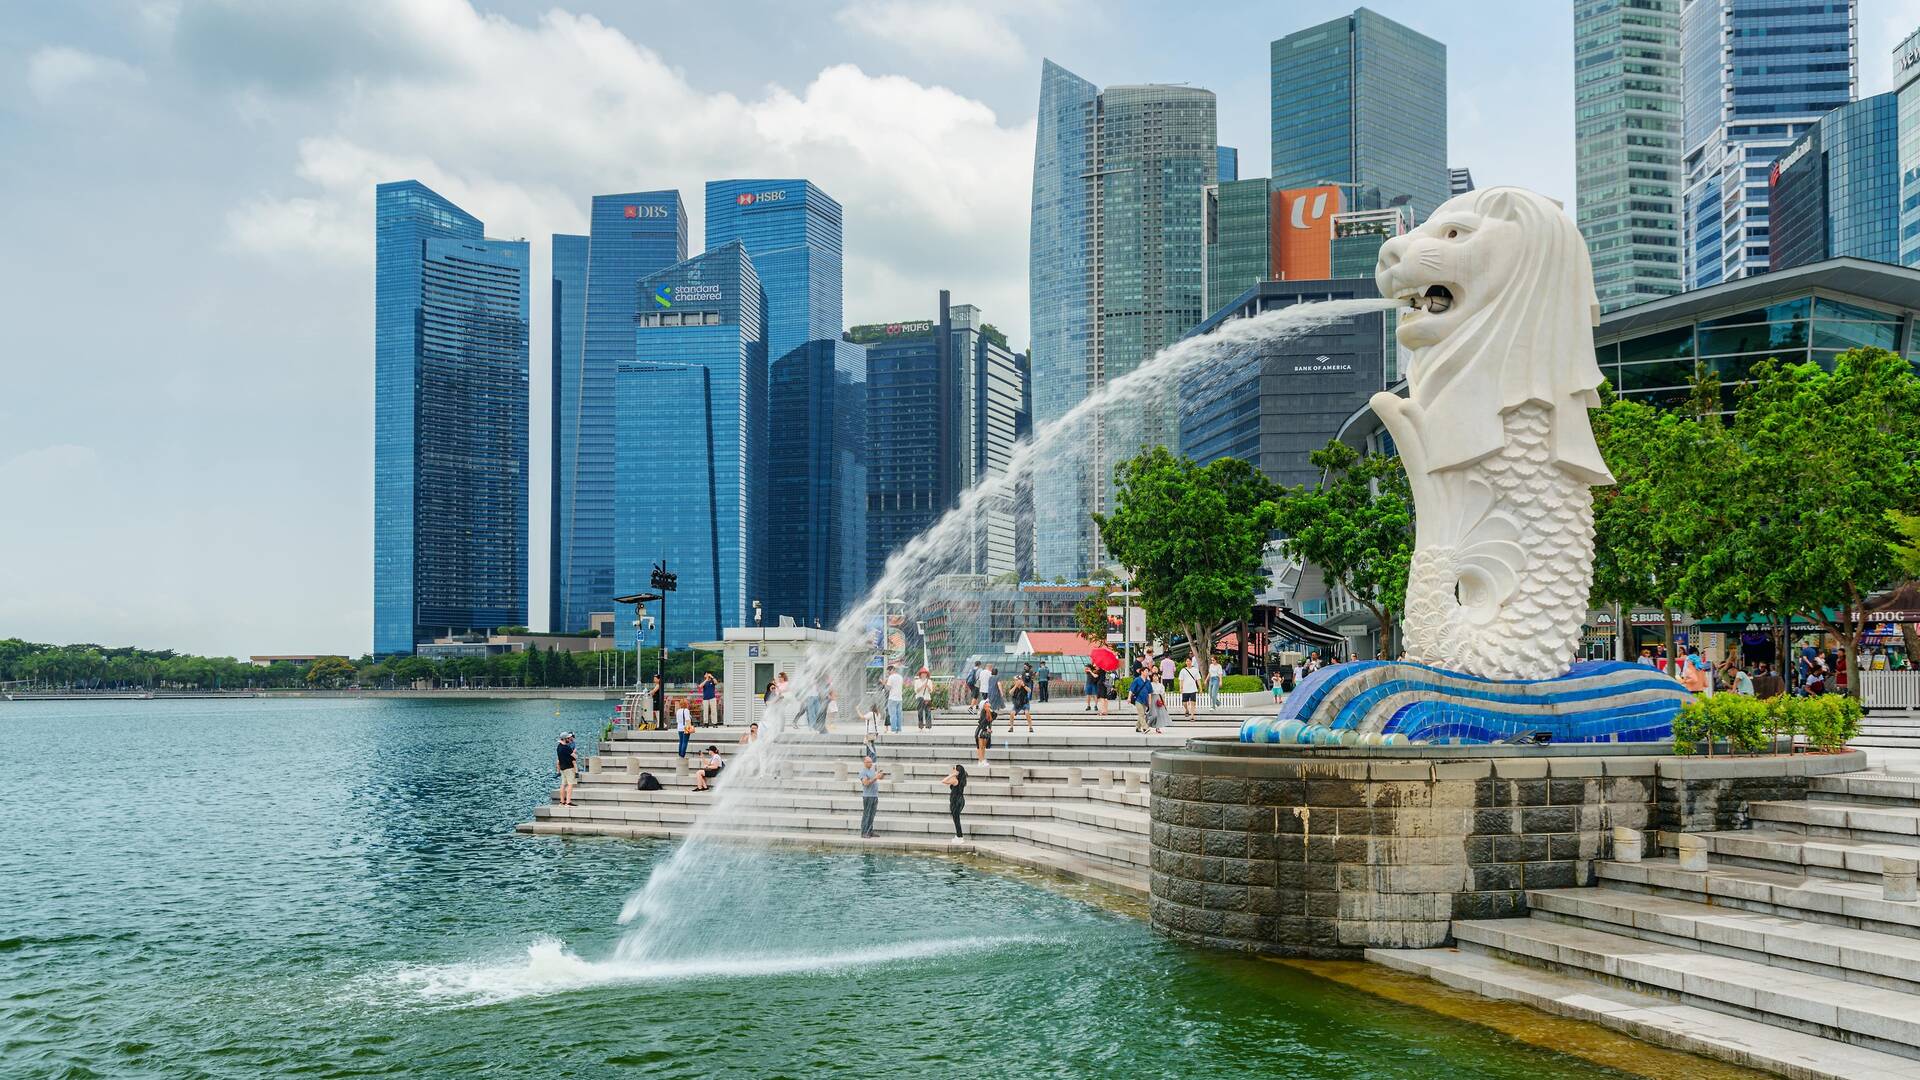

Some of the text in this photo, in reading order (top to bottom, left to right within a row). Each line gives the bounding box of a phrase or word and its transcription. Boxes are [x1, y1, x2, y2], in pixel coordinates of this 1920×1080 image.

[755, 190, 786, 203] HSBC
[638, 206, 668, 218] DBS
[675, 284, 719, 294] standard
[675, 292, 722, 302] chartered
[902, 322, 929, 333] MUFG
[1851, 611, 1905, 622] HTDOG
